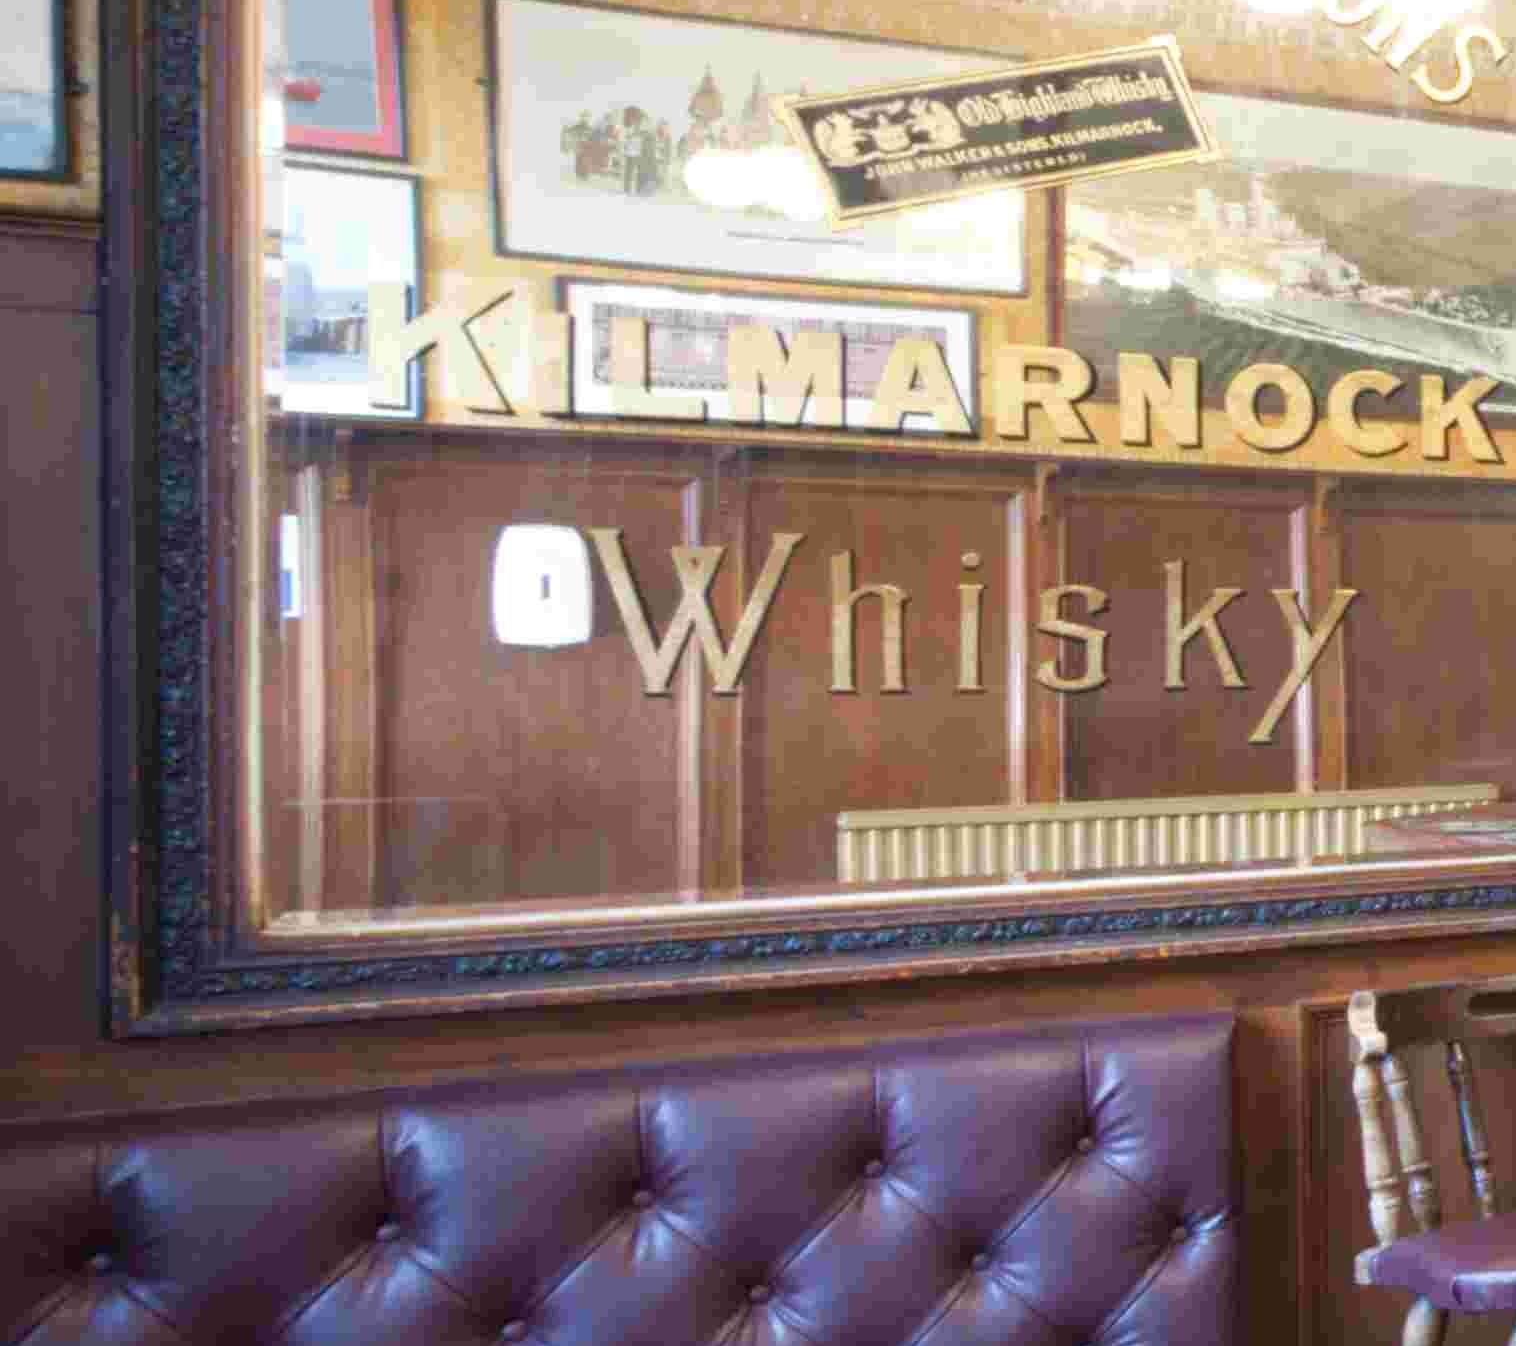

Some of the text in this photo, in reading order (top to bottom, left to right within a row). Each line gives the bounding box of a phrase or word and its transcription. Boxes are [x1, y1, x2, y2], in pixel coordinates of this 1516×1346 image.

[915, 147, 990, 170] WALKER
[366, 283, 1506, 467] KILMARNOCK
[587, 525, 1360, 746] Whisky
